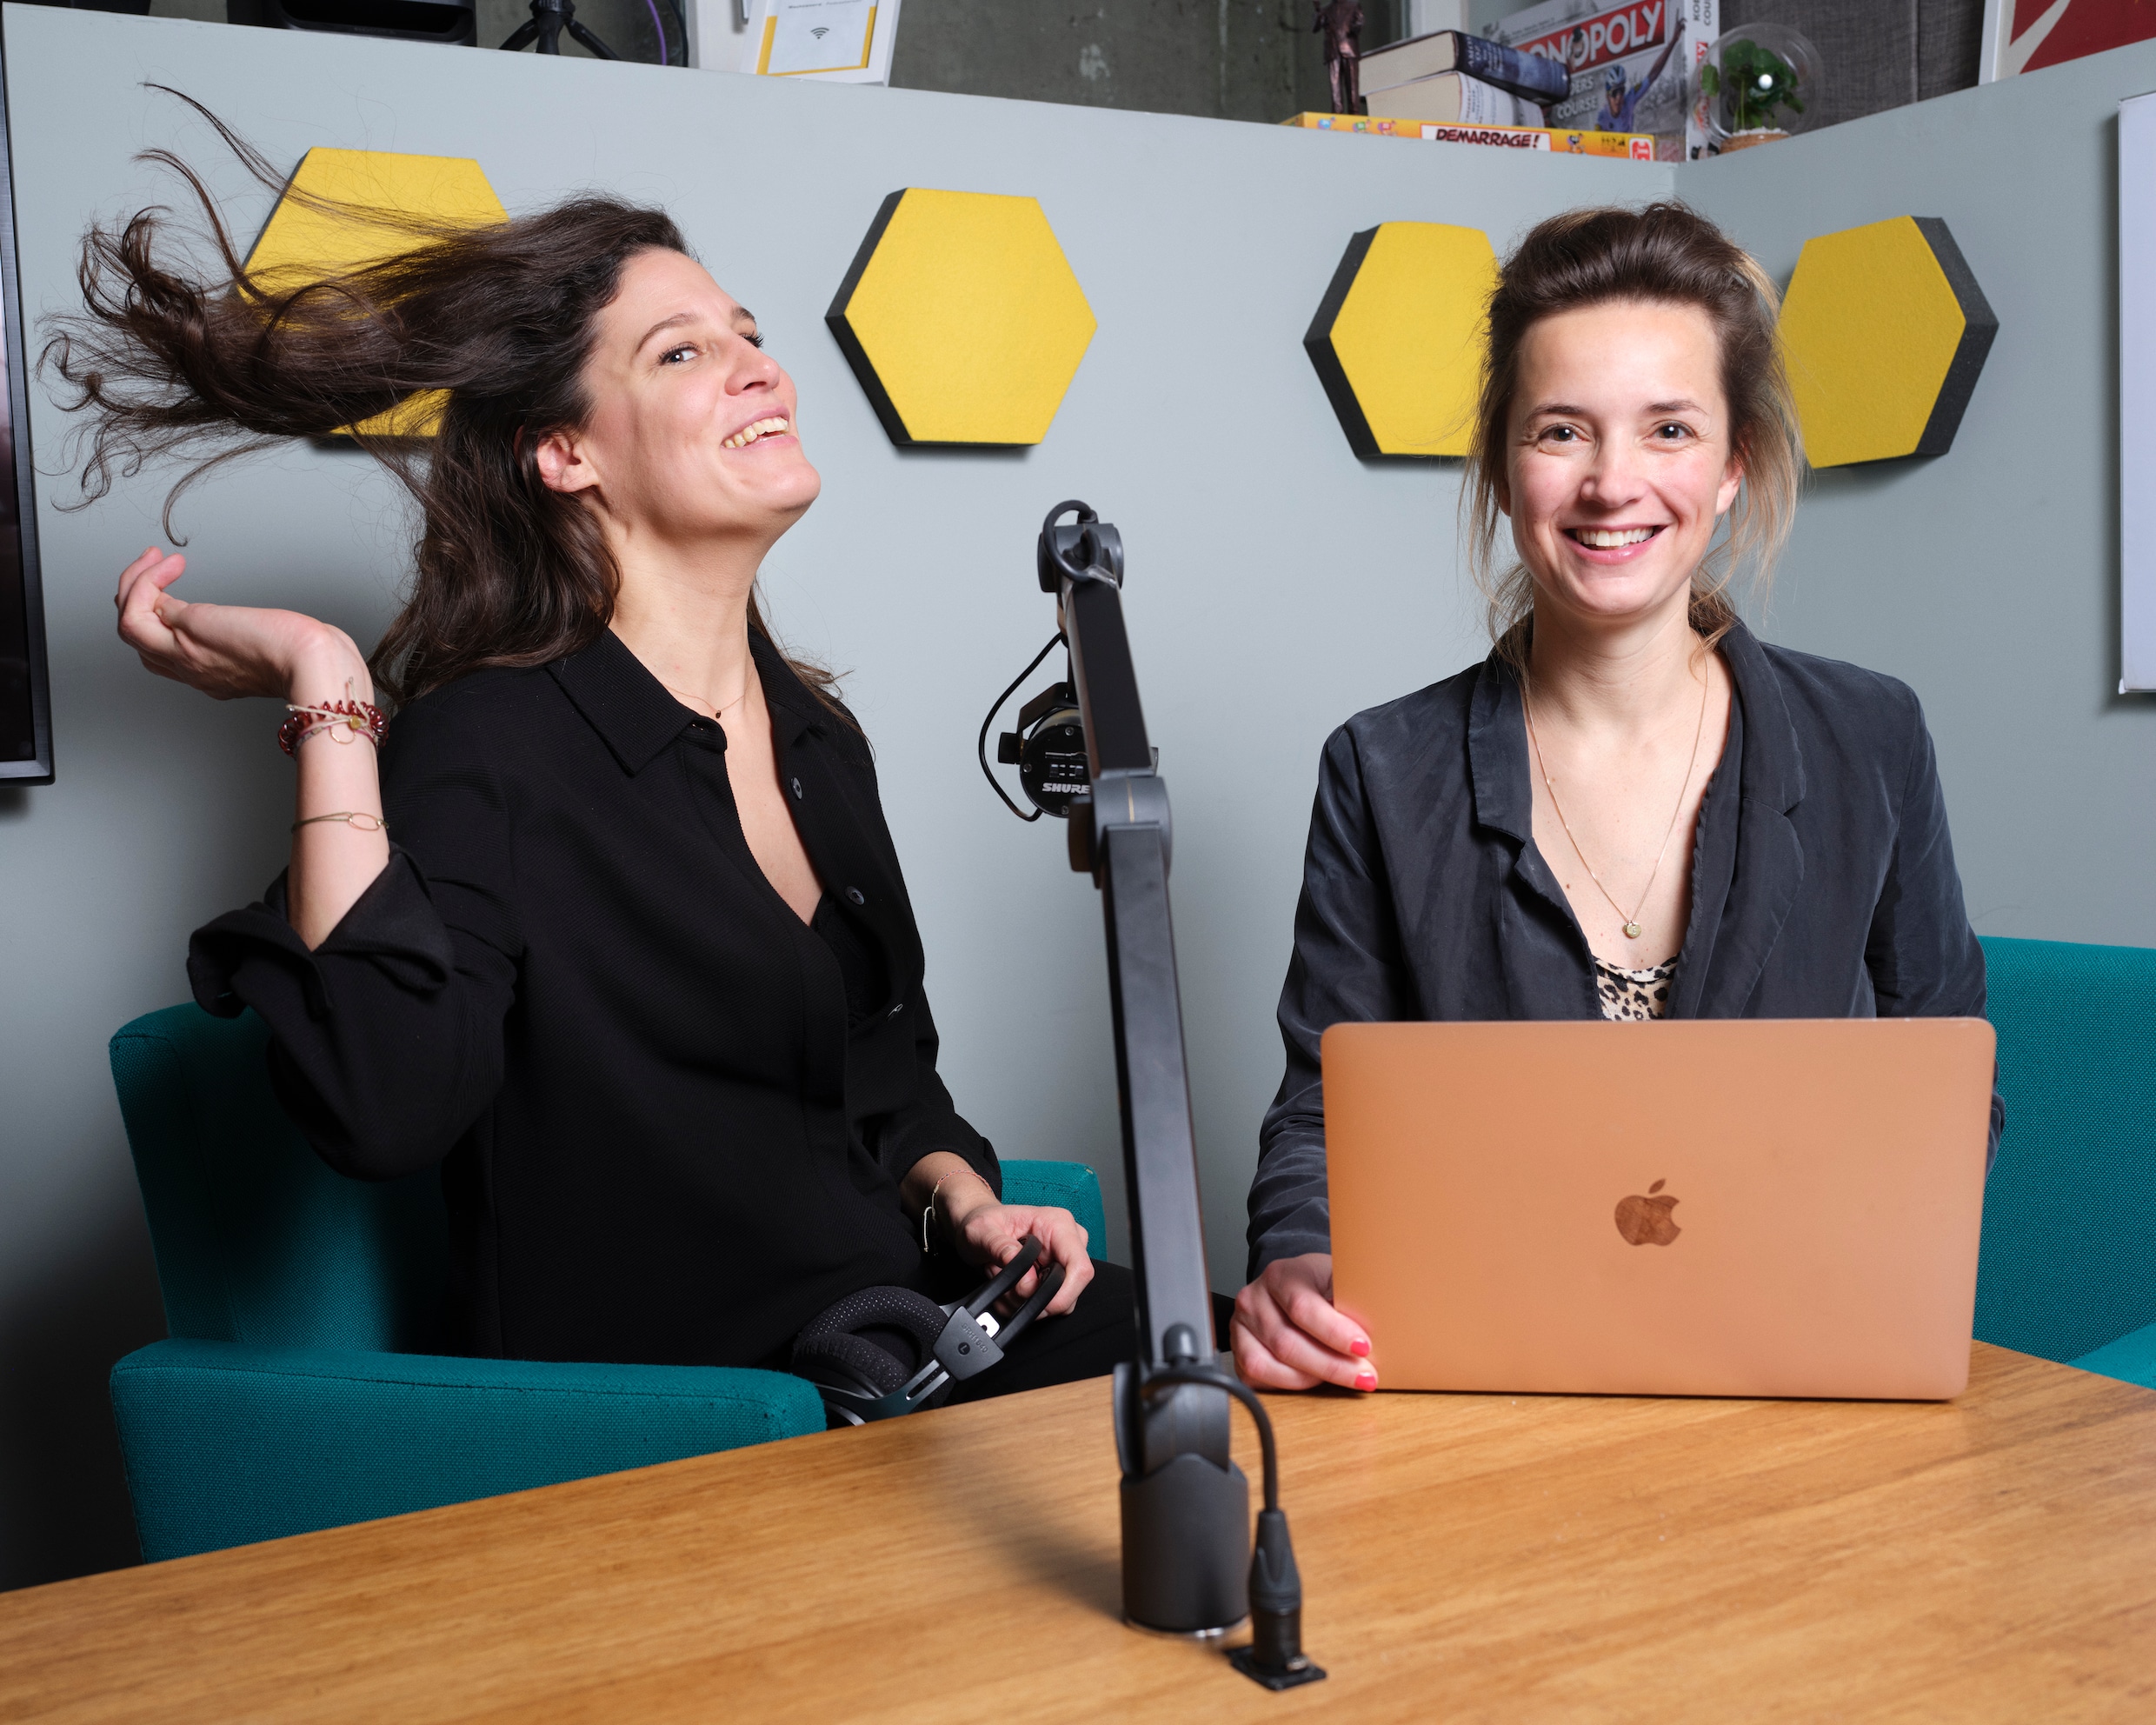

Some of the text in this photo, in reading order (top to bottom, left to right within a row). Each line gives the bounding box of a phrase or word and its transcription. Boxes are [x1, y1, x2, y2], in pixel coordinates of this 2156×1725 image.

[1557, 96, 1599, 120] COURSE
[1436, 128, 1540, 149] DEMARRAGE!
[1042, 783, 1091, 795] SHURE
